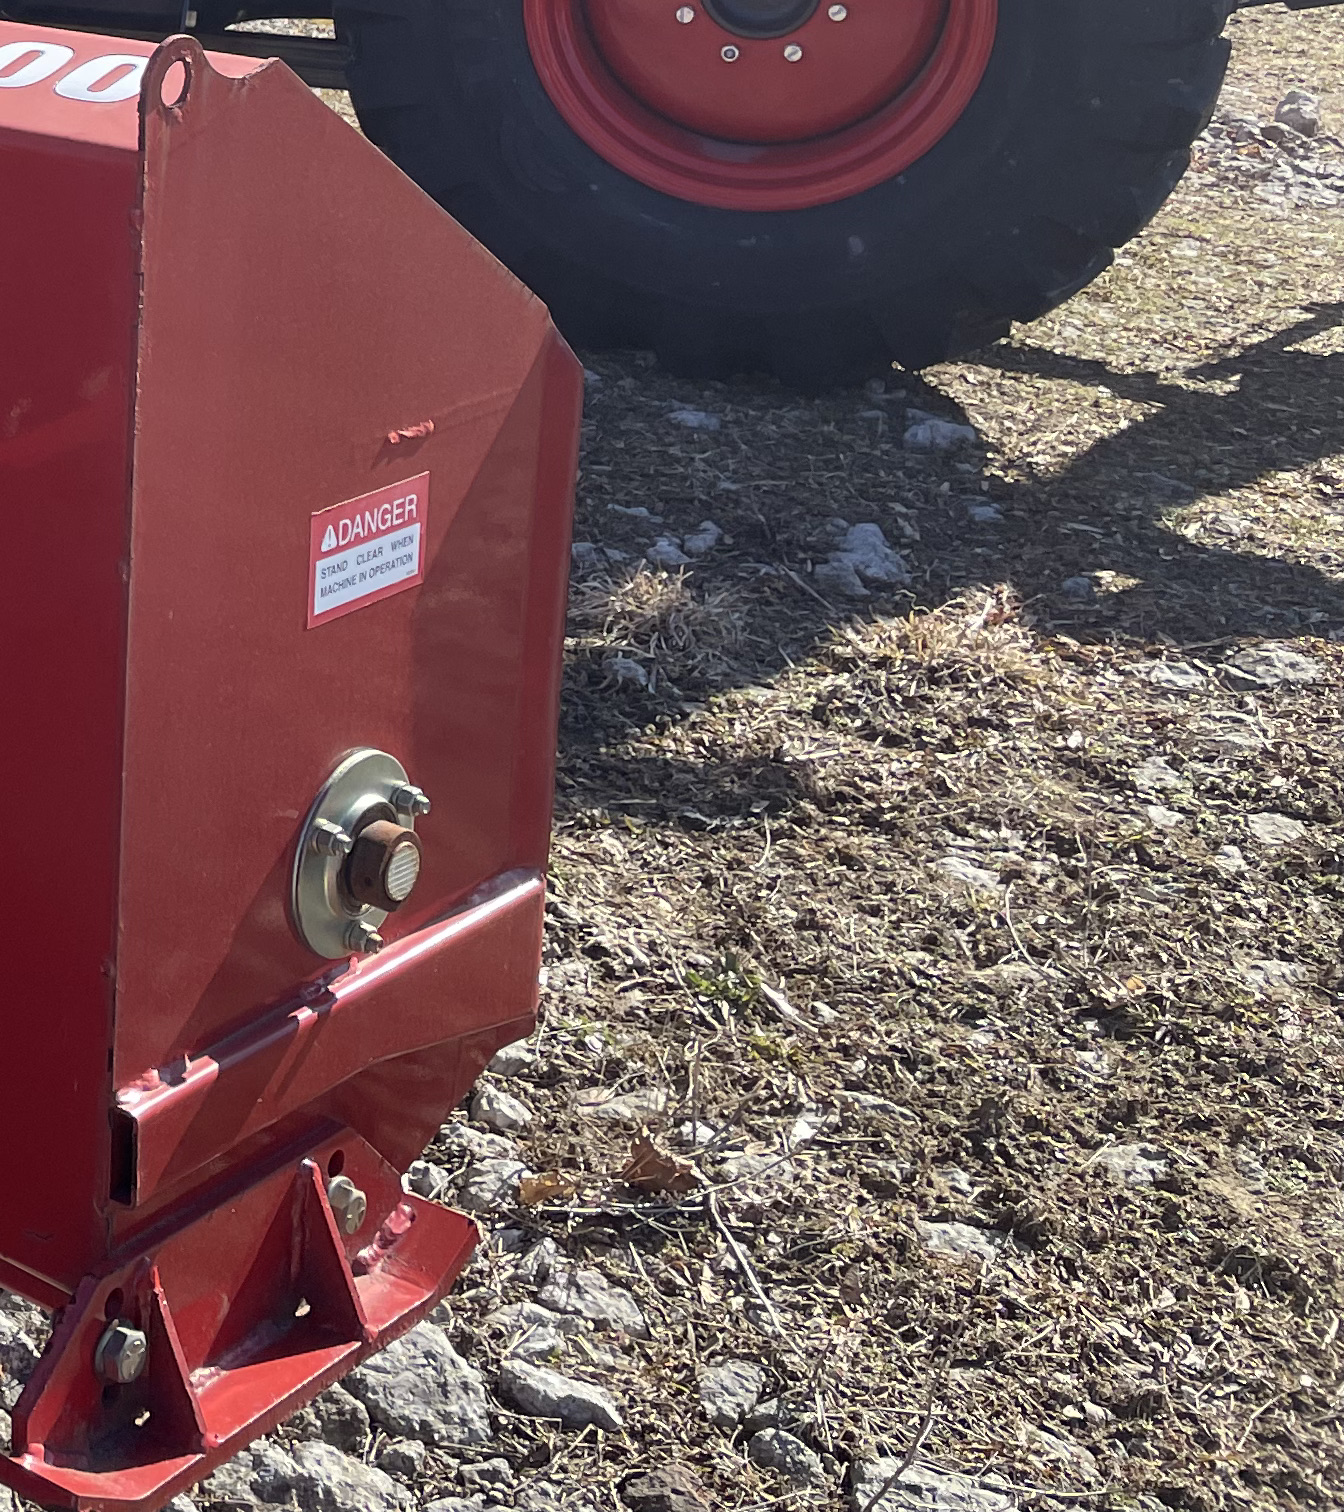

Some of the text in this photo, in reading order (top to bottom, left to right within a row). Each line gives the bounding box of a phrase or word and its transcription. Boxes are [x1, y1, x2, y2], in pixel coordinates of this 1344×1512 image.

[338, 494, 418, 546] DANGER
[320, 551, 414, 598] MACHINE IN OPERATION
[321, 534, 414, 580] STAND CLEAR WHEN
